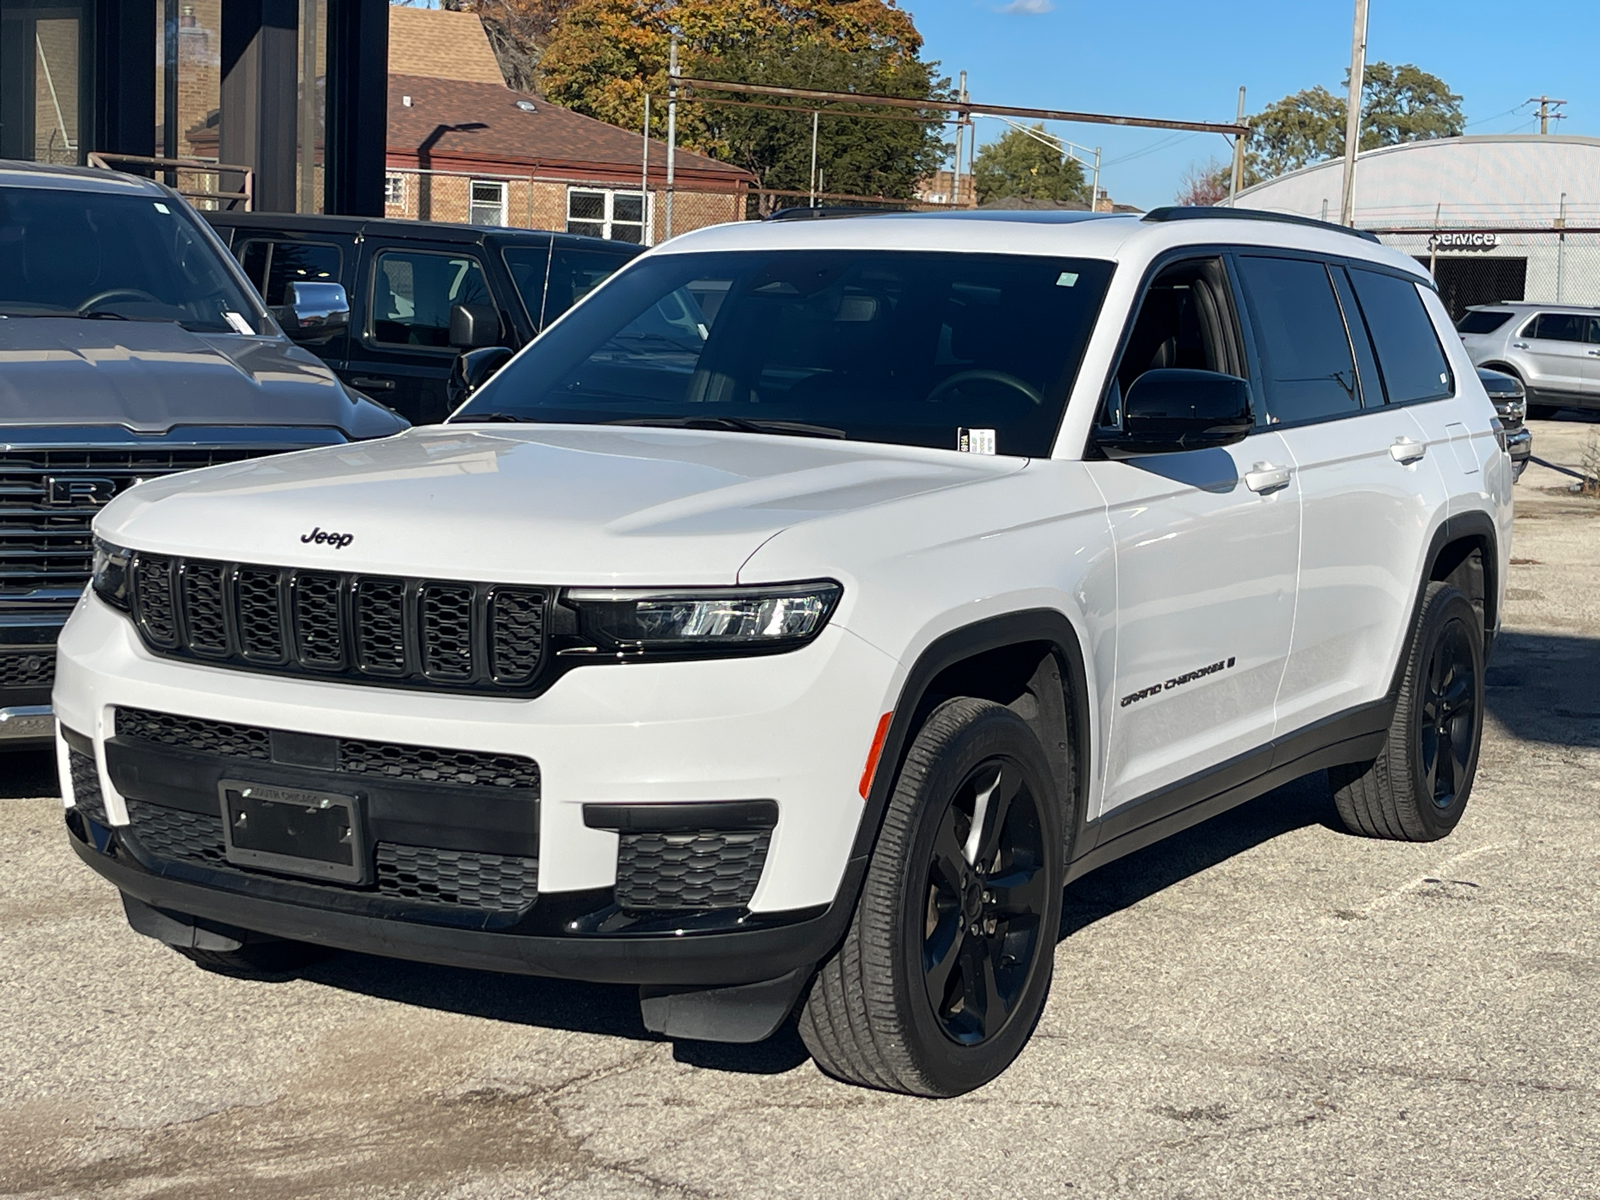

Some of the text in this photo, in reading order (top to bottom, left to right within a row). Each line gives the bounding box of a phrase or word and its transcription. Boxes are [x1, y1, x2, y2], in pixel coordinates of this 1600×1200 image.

[300, 527, 354, 550] Jeep
[1120, 683, 1162, 708] GRAND
[1164, 660, 1226, 690] CHEROKEE
